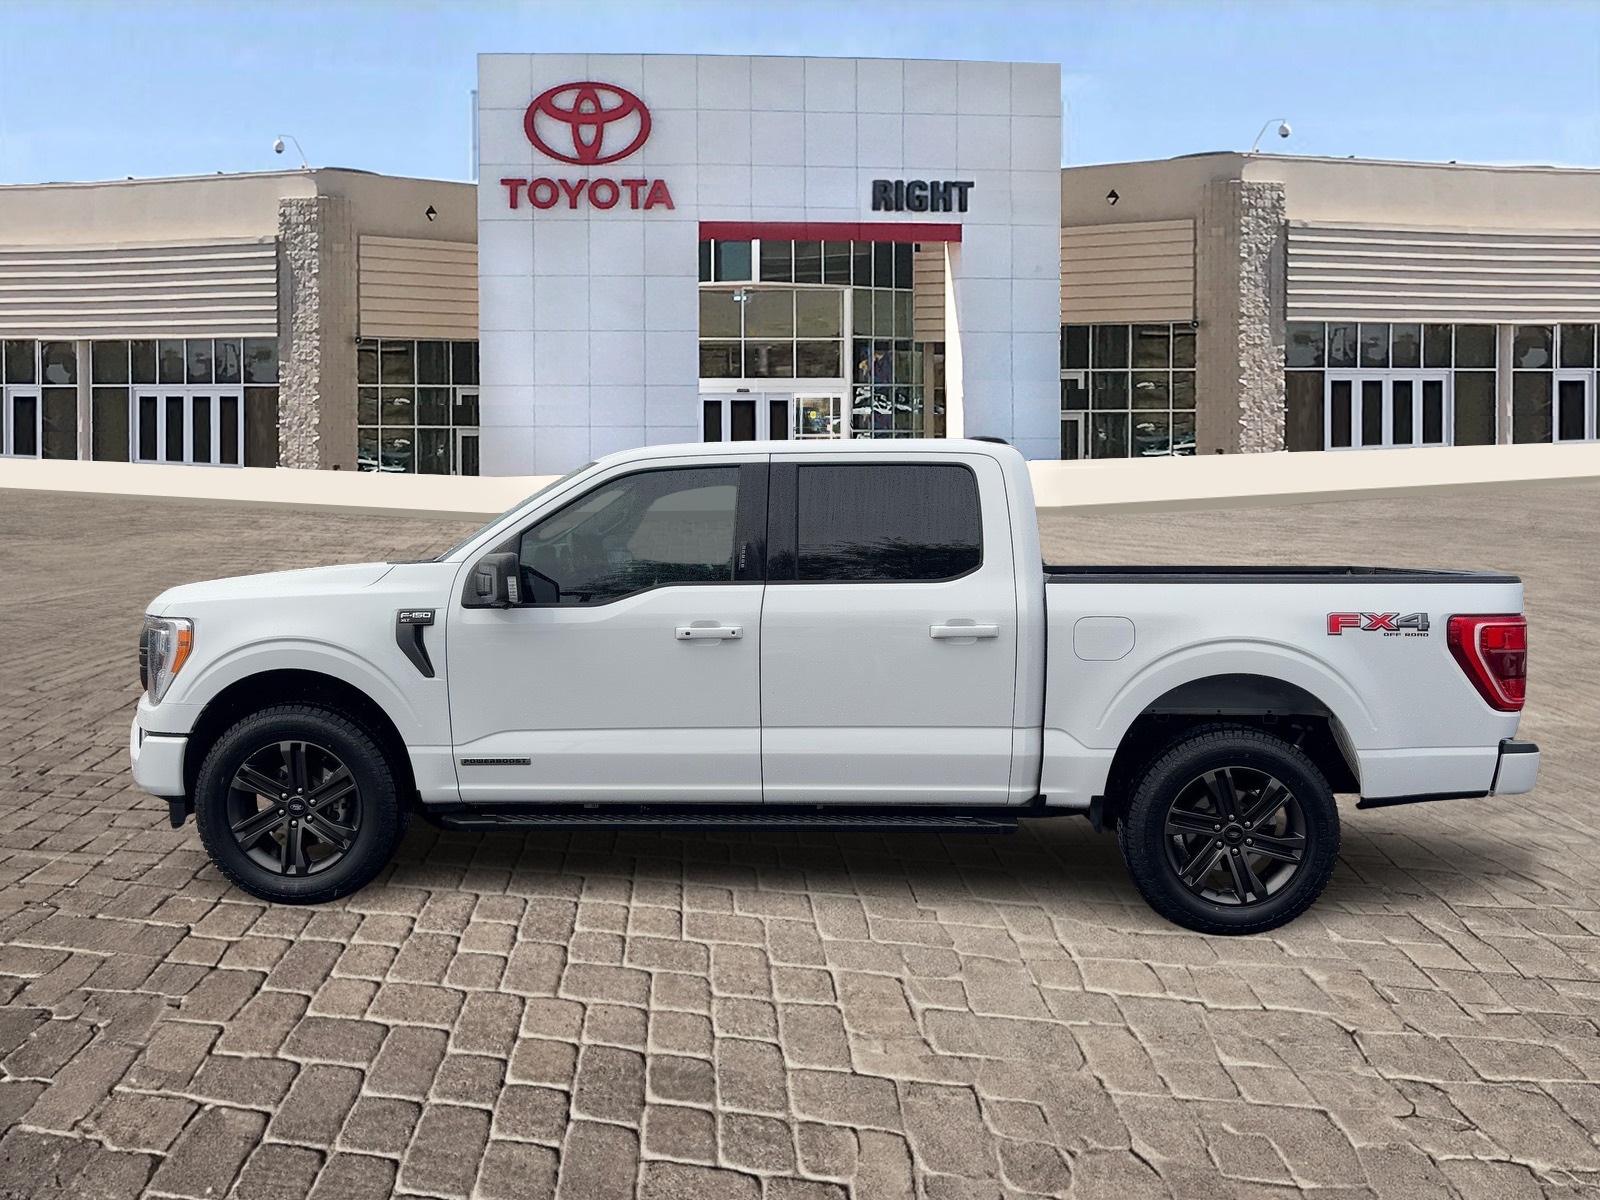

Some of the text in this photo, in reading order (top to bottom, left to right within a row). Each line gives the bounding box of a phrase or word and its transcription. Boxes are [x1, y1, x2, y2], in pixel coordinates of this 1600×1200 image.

[500, 178, 675, 210] TOYOTA
[872, 179, 975, 212] RIGHT
[1326, 611, 1430, 636] FX4
